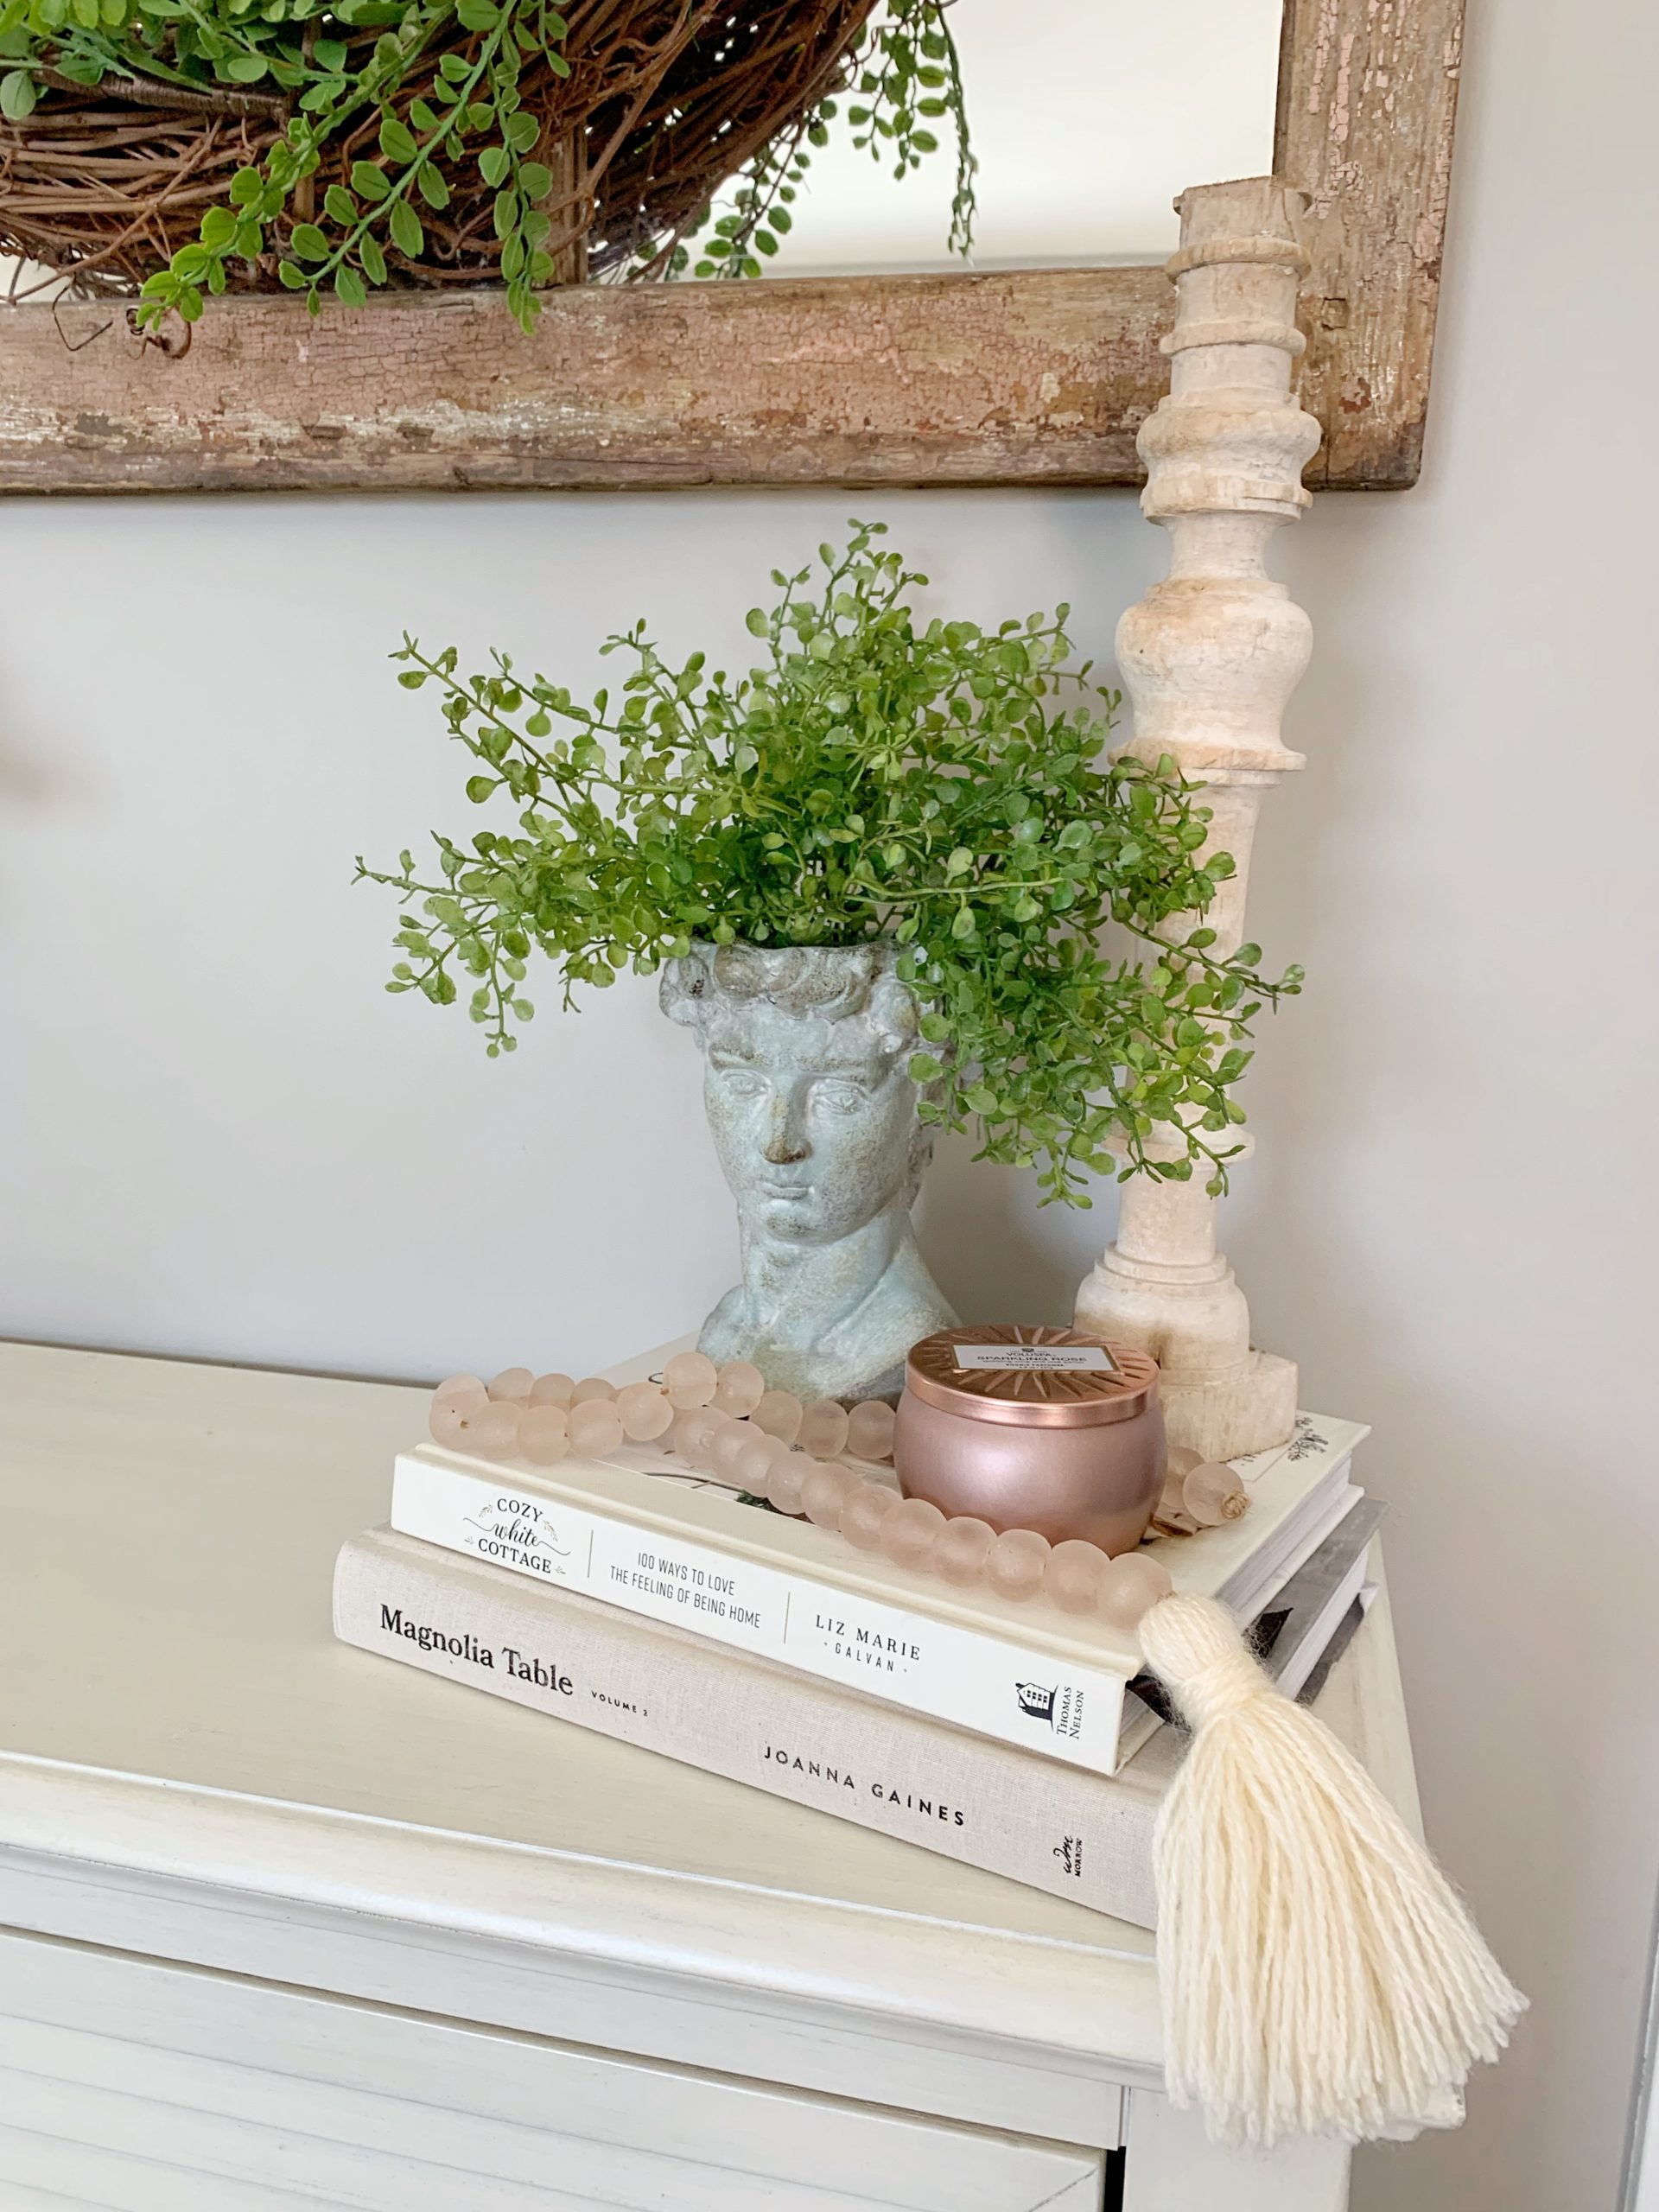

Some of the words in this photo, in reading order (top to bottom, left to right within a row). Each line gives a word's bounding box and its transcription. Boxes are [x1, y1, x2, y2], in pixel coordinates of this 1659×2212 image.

[497, 1498, 543, 1523] COZY
[478, 1538, 552, 1574] COTTAGE
[638, 1552, 656, 1569] 100
[658, 1556, 690, 1581] WAYS
[692, 1568, 706, 1586] TO
[708, 1573, 735, 1597] LOVE
[610, 1566, 630, 1586] THE
[632, 1573, 674, 1600] FEELING
[677, 1588, 690, 1605] OF
[694, 1593, 726, 1618] BEING
[729, 1605, 761, 1629] HOME
[380, 1604, 494, 1669] Magnolia
[502, 1646, 574, 1696] Table
[816, 1614, 845, 1637] LIZ
[855, 1628, 921, 1661] MARIE
[835, 1643, 894, 1672] GALVAN
[591, 1690, 638, 1713] VOLUME
[643, 1708, 649, 1717] 2
[764, 1745, 855, 1789] JOANNA
[871, 1783, 964, 1827] GAINES
[1074, 1837, 1083, 1877] MORROW
